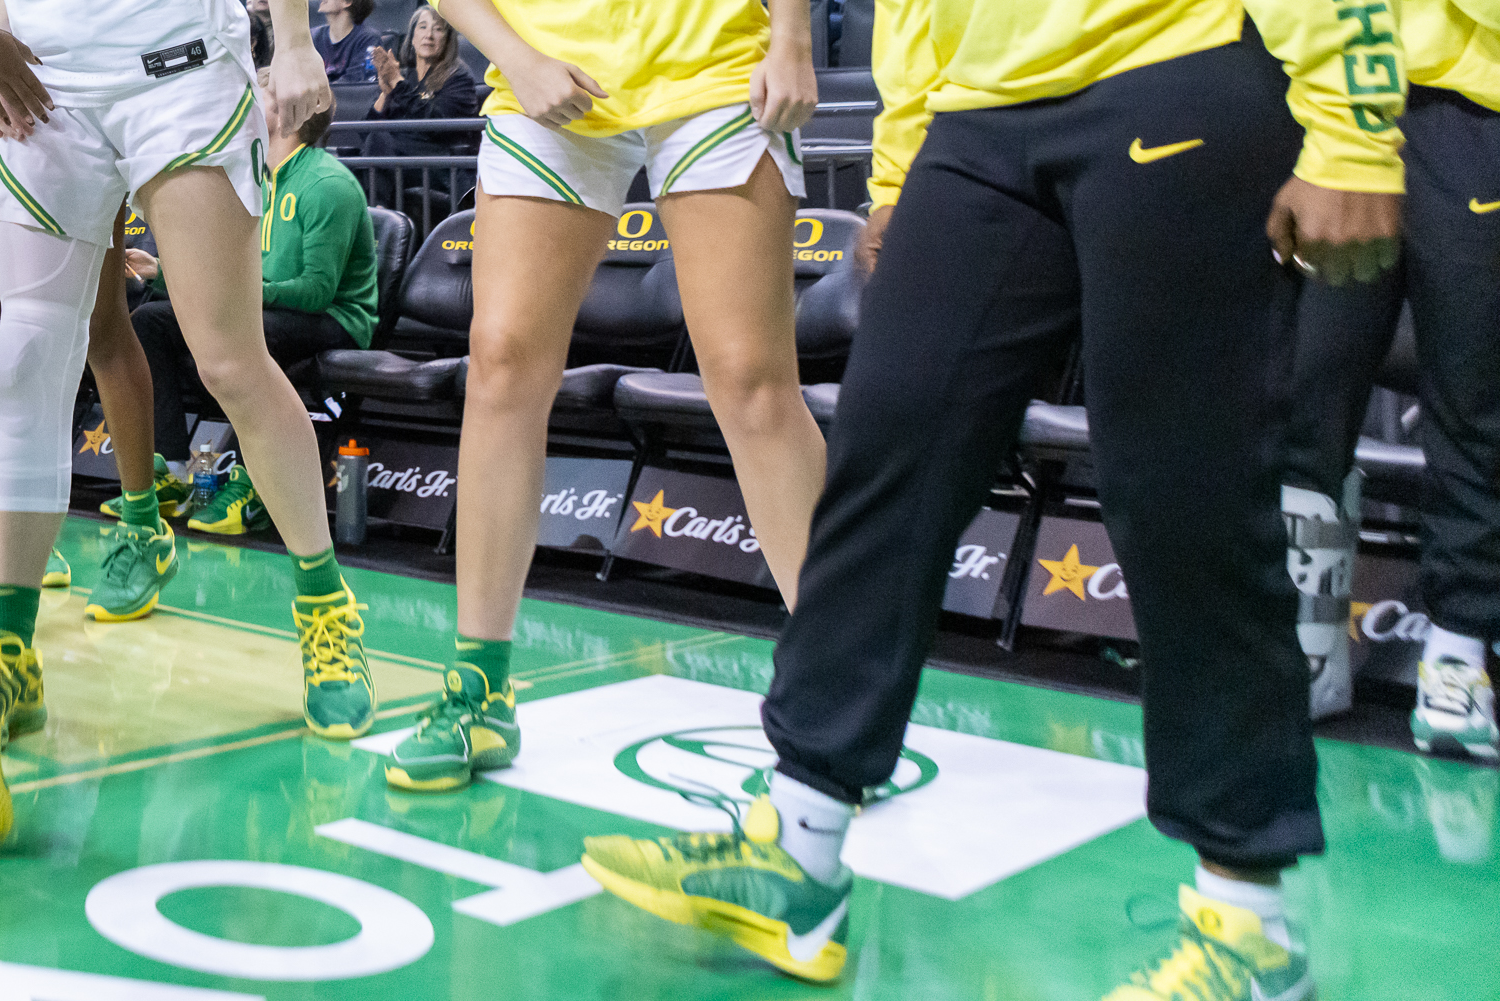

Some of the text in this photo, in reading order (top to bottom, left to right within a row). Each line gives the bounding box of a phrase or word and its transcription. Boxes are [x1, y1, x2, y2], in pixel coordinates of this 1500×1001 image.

[606, 238, 671, 252] REGON
[366, 462, 456, 498] Carl's Jr.
[574, 490, 611, 521] Jr.
[664, 506, 746, 545] Carl's
